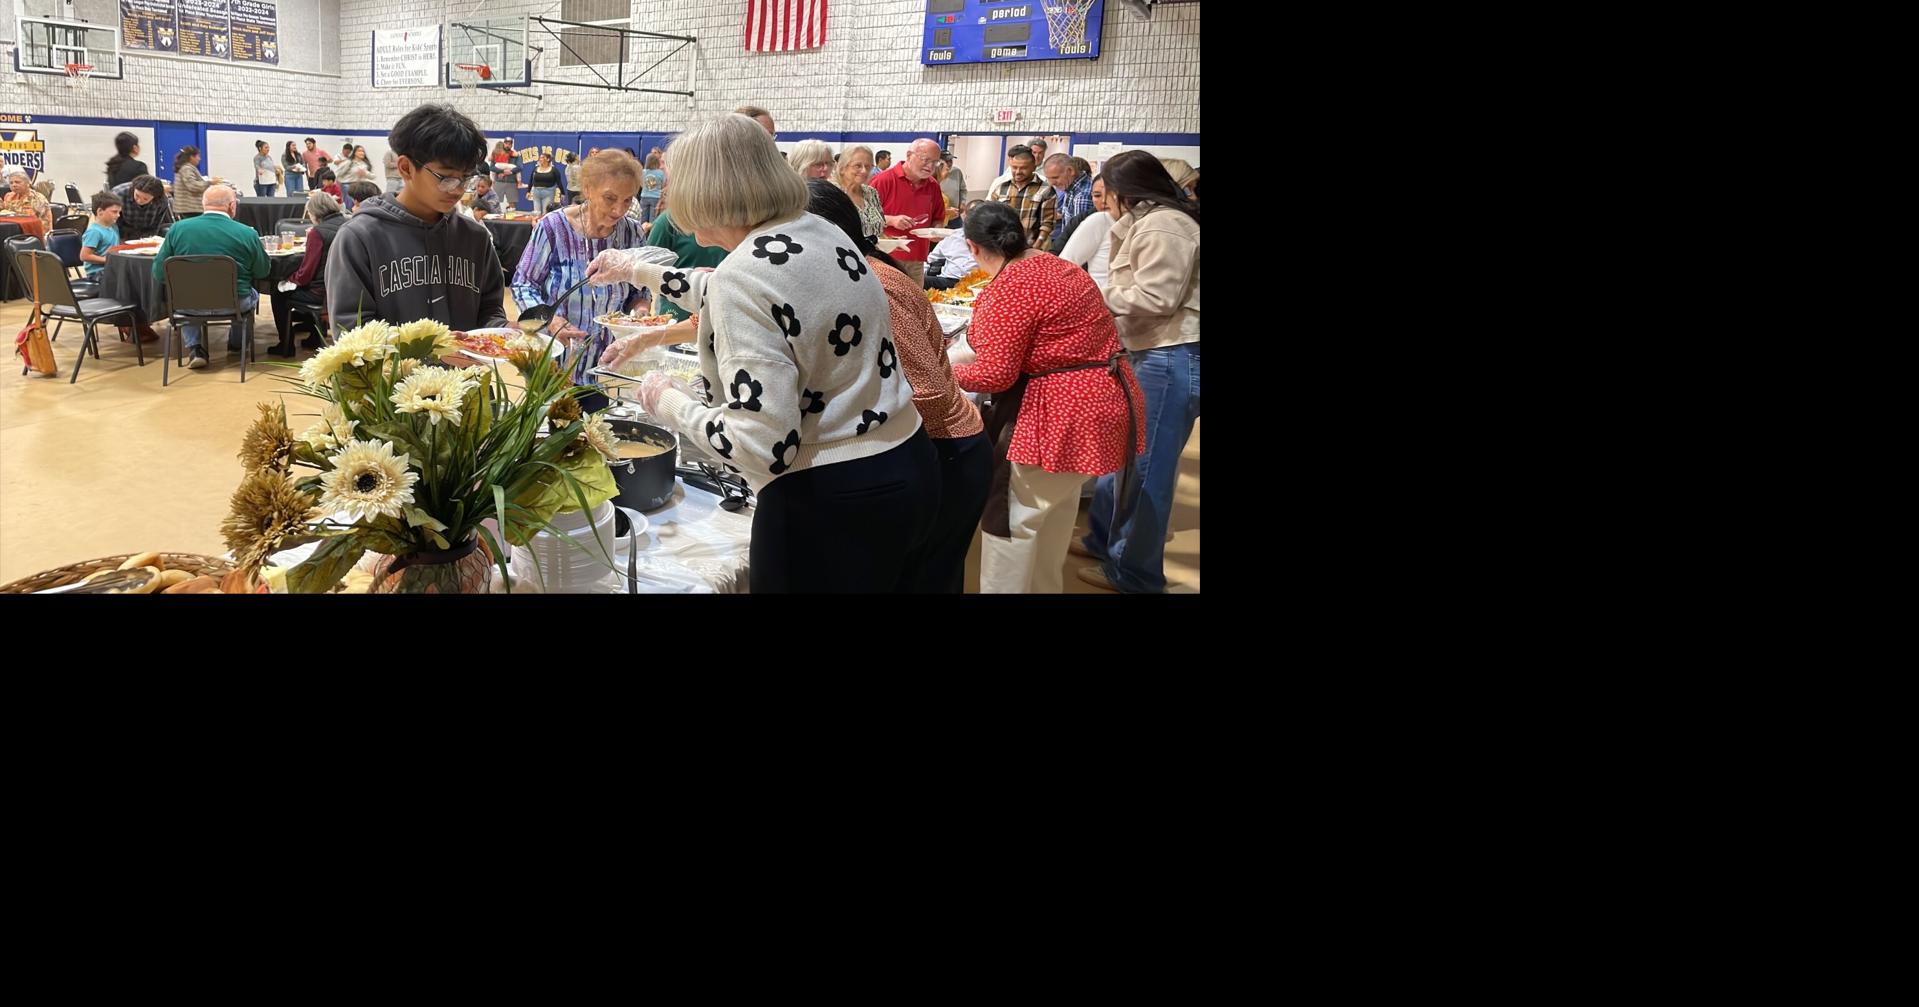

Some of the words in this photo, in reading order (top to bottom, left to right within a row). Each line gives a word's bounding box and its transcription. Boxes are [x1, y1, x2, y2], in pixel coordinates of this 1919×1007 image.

[242, 0, 260, 8] Grade
[992, 6, 1026, 20] period
[991, 47, 1017, 58] game
[1060, 43, 1086, 55] fouls
[401, 53, 417, 61] CHRIST
[929, 50, 952, 61] fouls
[391, 70, 404, 78] GOOD
[998, 110, 1013, 120] EXIT
[0, 152, 40, 169] NDERS
[520, 146, 539, 164] HIS
[379, 254, 442, 297] CASCIA
[444, 255, 480, 293] HALL
